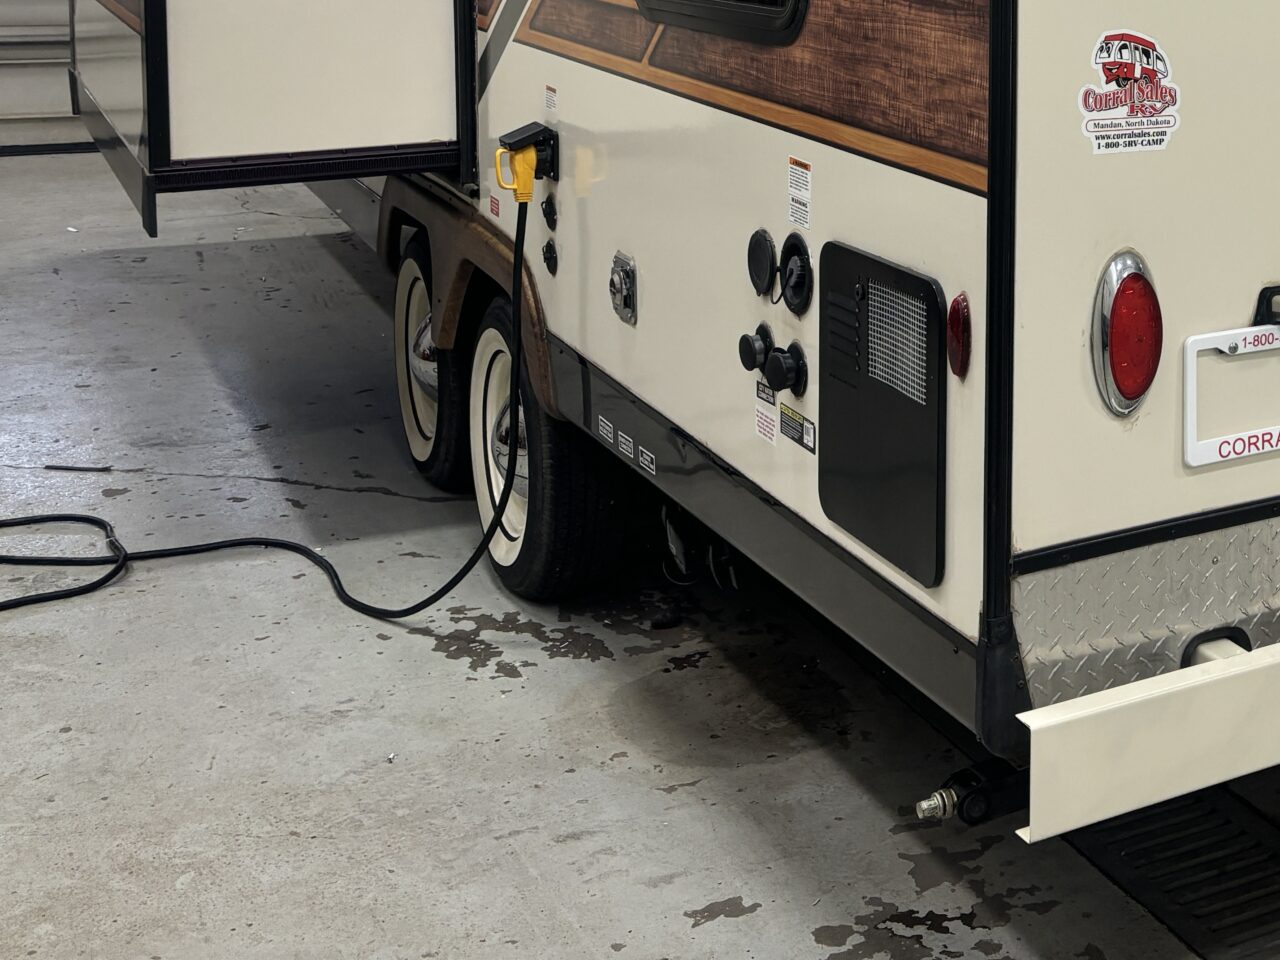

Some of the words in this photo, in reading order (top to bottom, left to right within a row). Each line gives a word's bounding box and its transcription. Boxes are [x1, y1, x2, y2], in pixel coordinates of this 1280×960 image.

[1082, 80, 1135, 112] Corral
[1136, 79, 1177, 106] Sales
[1127, 102, 1171, 117] RV
[1093, 120, 1124, 129] Mandan,
[1125, 119, 1145, 128] North
[1146, 118, 1171, 127] Dakota
[1095, 129, 1167, 140] www.corralsales.com
[1097, 138, 1164, 149] 1-800-5RV-CAMP
